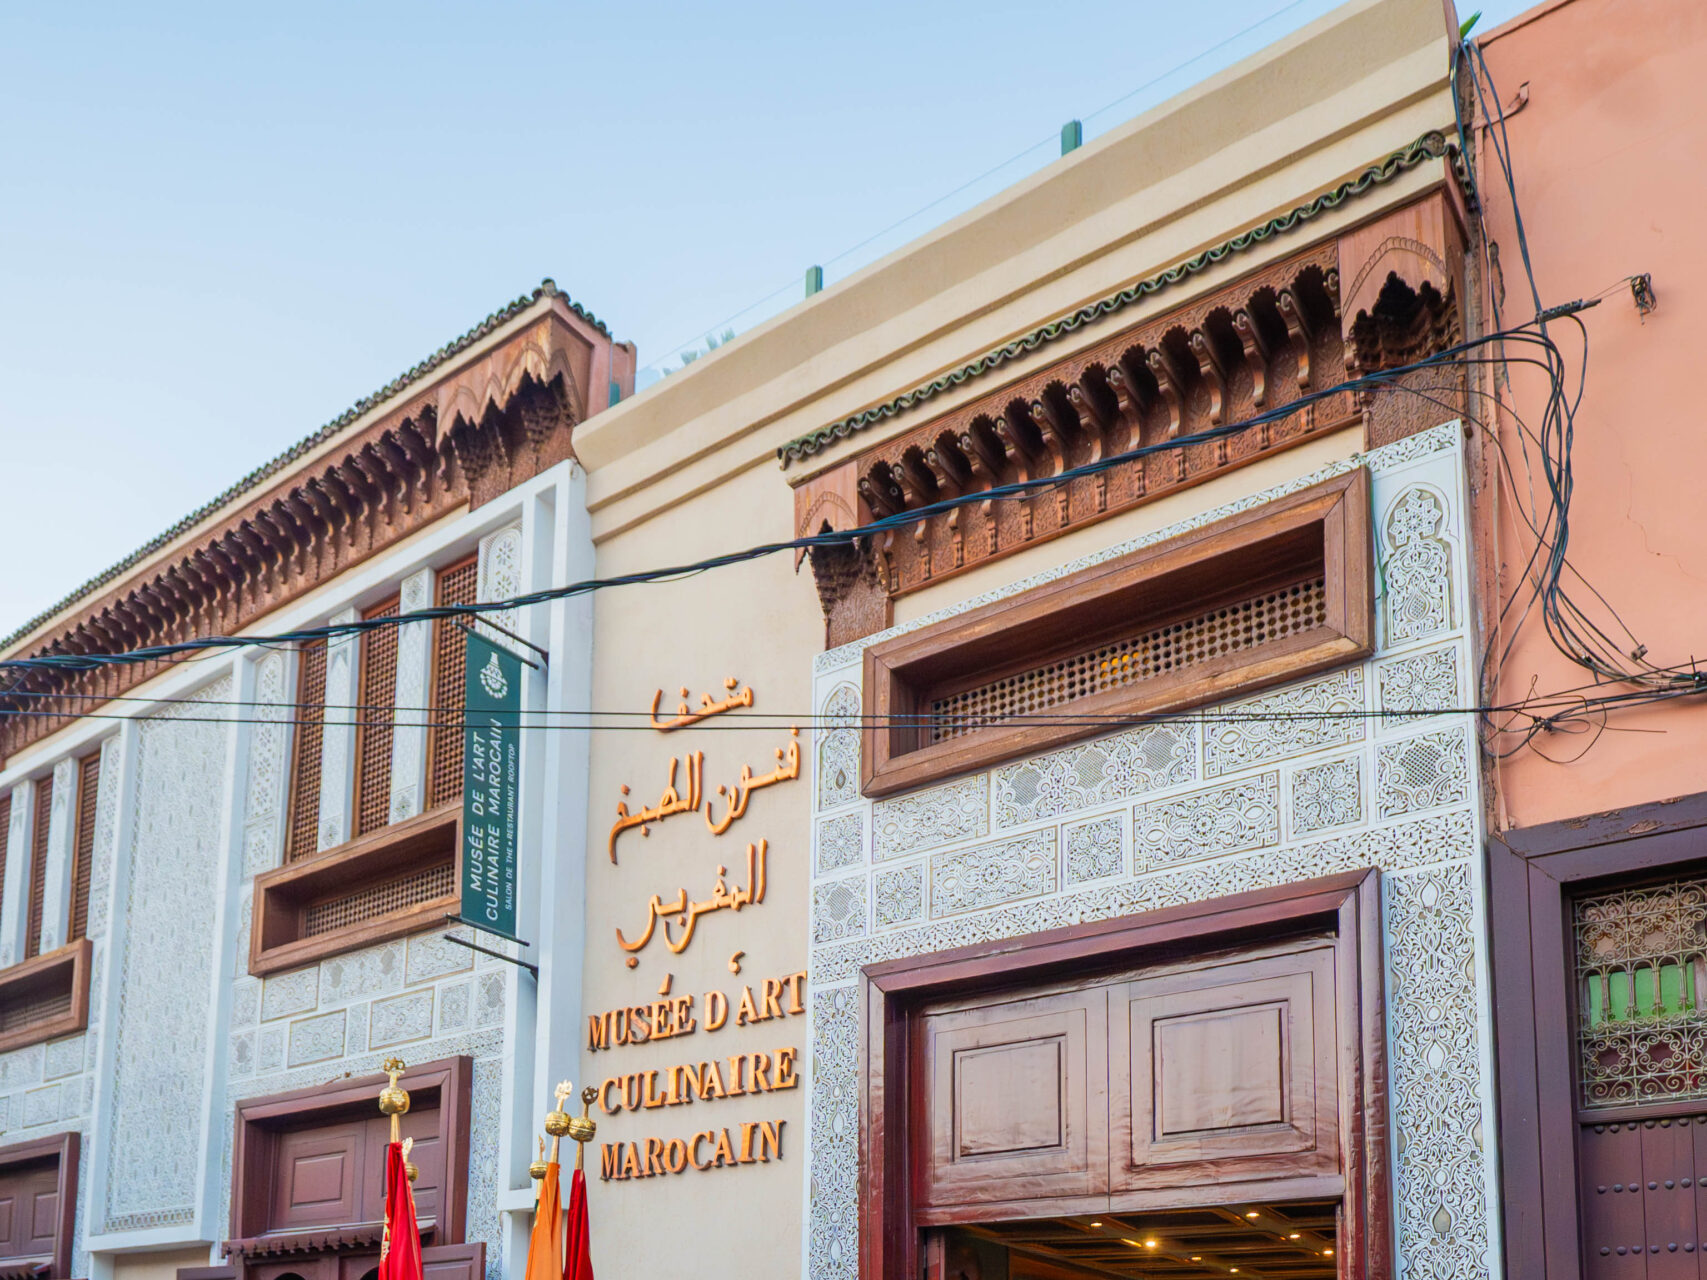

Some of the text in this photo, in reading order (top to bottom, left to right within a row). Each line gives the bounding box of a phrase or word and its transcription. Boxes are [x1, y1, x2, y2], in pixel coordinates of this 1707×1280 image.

[651, 676, 754, 733] متحف
[508, 743, 516, 783] ROOFTOP
[608, 724, 800, 866] فنون الطبخ
[468, 731, 485, 892] MUSÉE DE L'ART
[486, 718, 502, 921] CULINAIRE MAROCAIN
[506, 784, 515, 840] RESTAURANT
[504, 881, 513, 911] SALON
[505, 866, 513, 879] DE
[615, 837, 768, 970] المغربي
[586, 973, 697, 1053] MUSÉE
[597, 1047, 800, 1116] CULINAIRE
[599, 1119, 787, 1182] MAROCAIN
